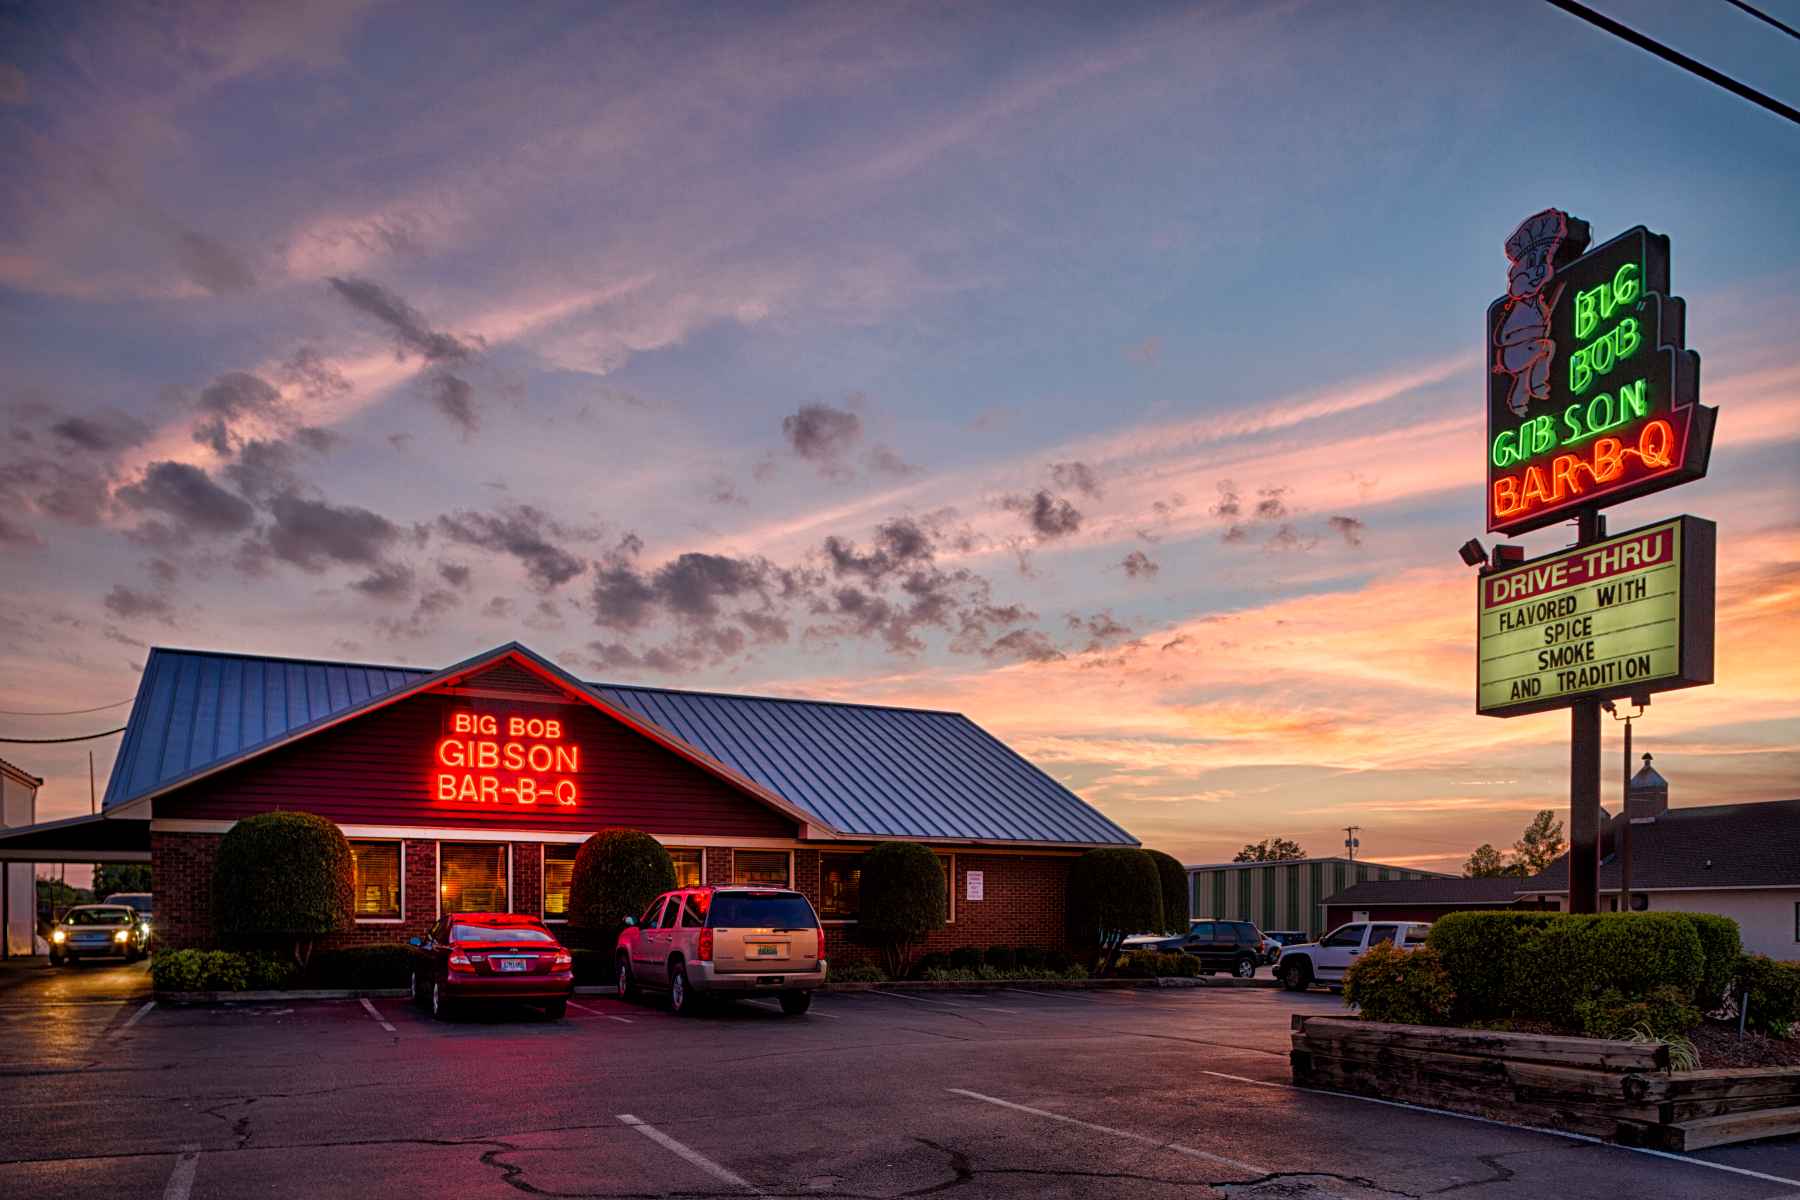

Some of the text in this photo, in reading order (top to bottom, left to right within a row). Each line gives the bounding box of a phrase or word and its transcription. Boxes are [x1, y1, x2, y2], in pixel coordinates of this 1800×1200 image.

[1574, 263, 1640, 339] BIG
[1569, 318, 1642, 395] BOB
[1492, 378, 1648, 468] GIBSON
[1493, 420, 1674, 517] BAR-B-Q
[1492, 536, 1663, 603] DRIVE-THRU
[1499, 577, 1647, 632] FLAVORED WITH
[1544, 616, 1593, 645] SPICE
[1510, 655, 1651, 701] AND TRADITION
[1538, 641, 1595, 671] SMOKE
[455, 713, 561, 739] BIG BOB
[439, 739, 578, 773] GIBSON
[437, 774, 577, 806] BAR-B-Q
